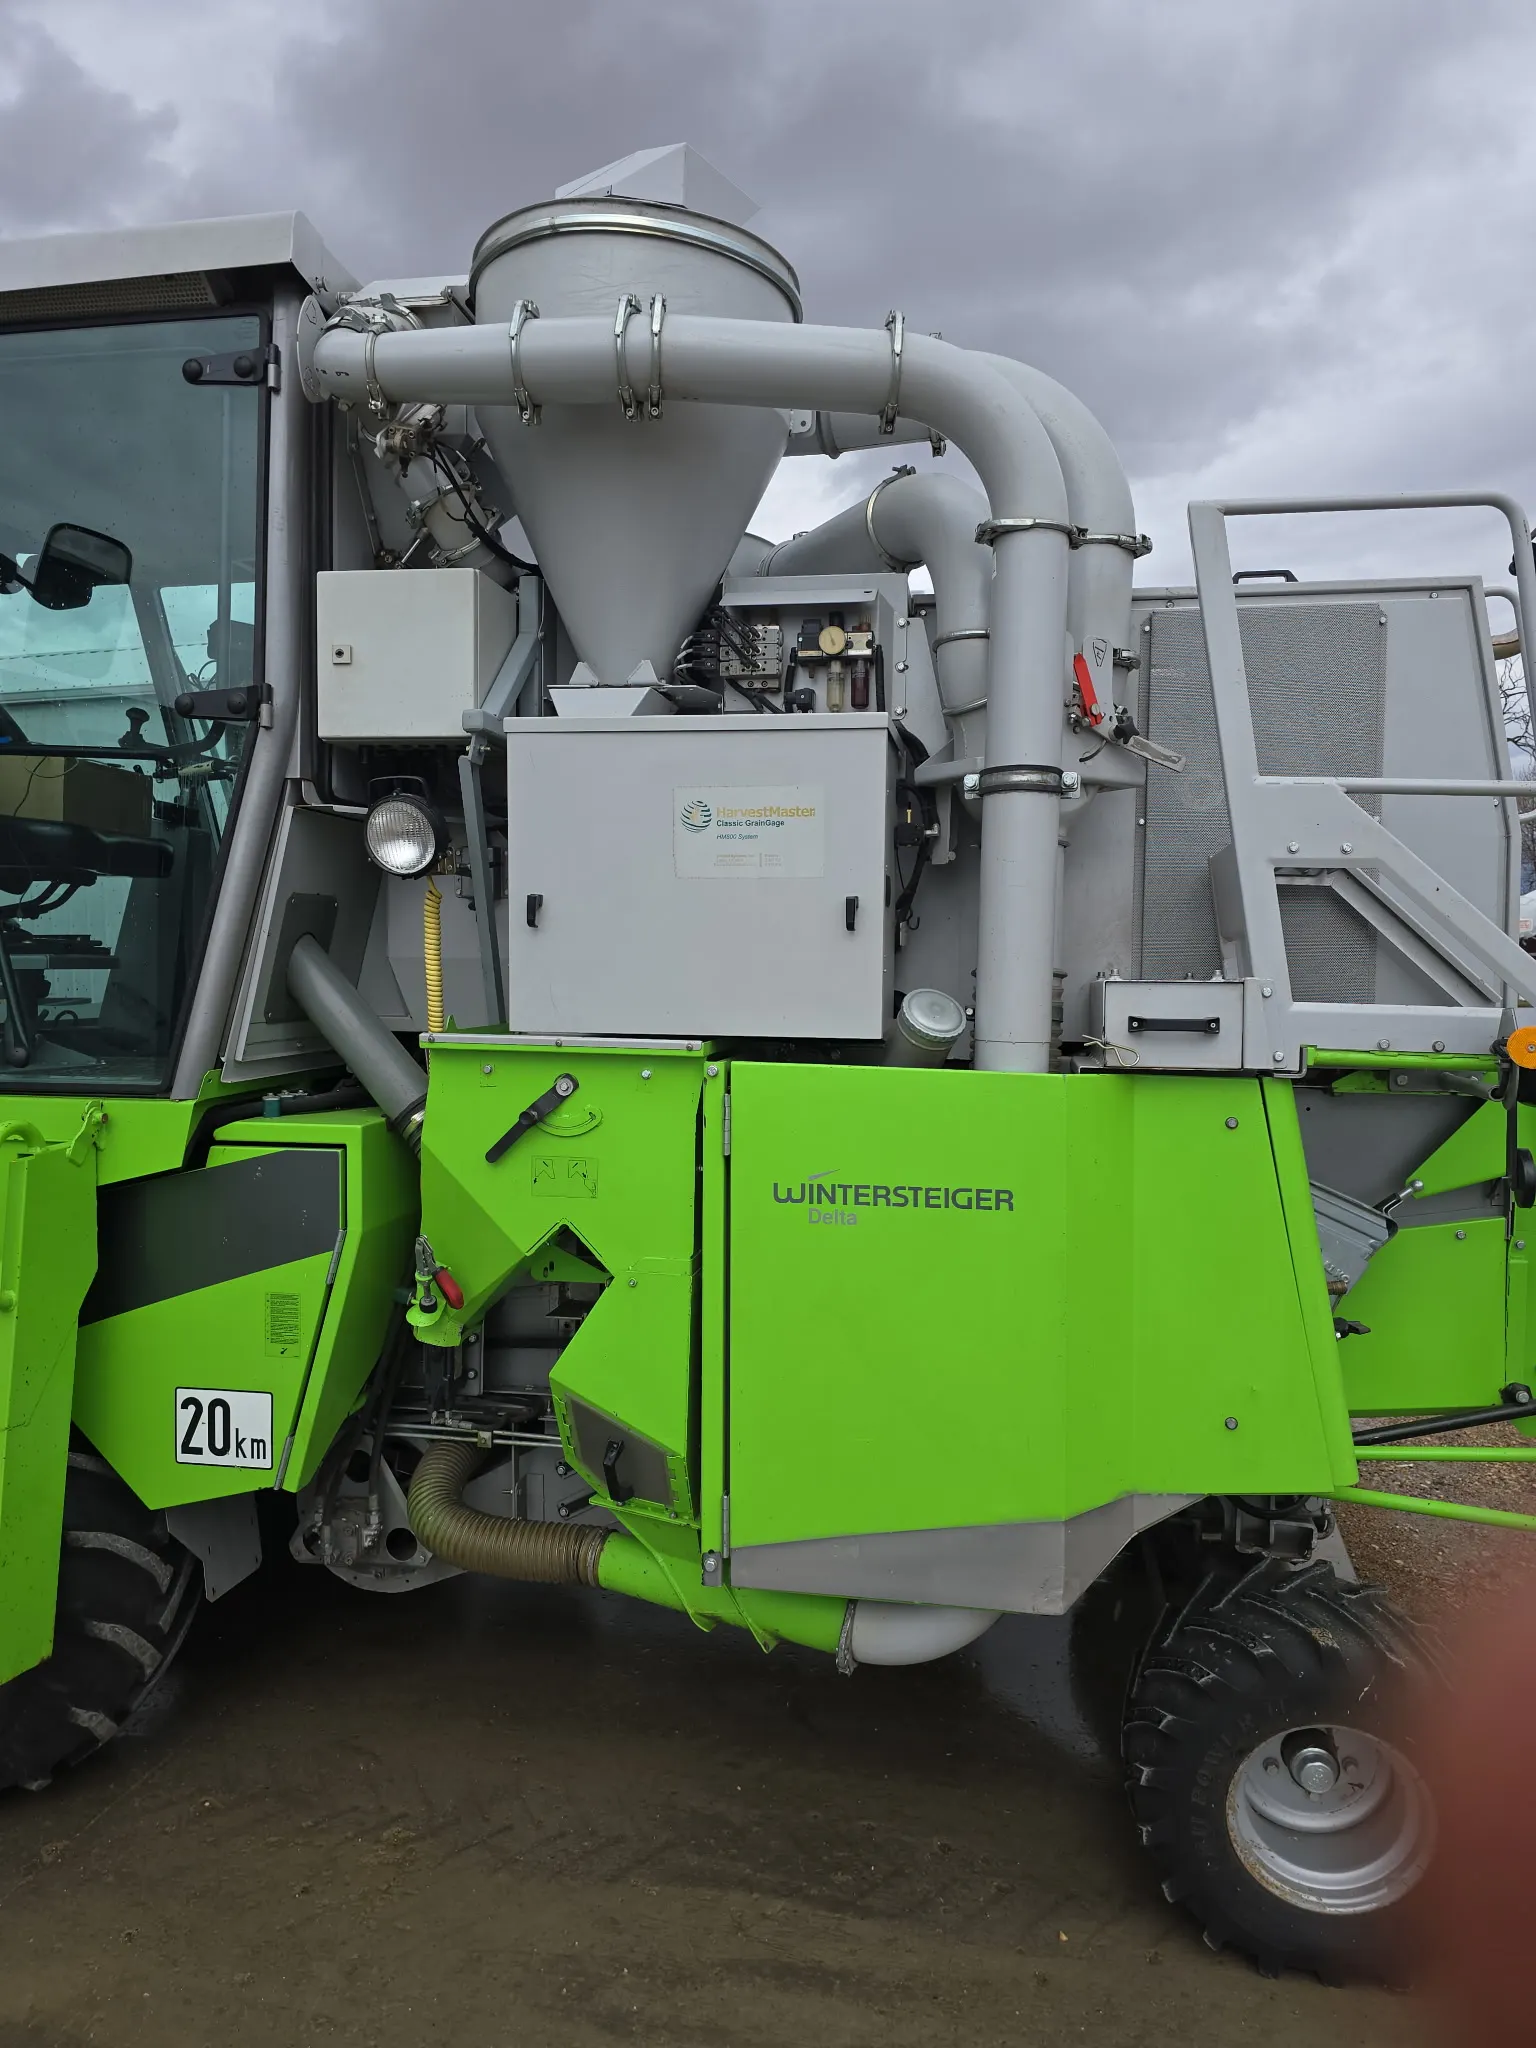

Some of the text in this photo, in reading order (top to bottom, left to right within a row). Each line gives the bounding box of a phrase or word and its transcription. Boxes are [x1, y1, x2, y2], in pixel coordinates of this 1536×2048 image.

[716, 805, 816, 819] HarvestMaster
[716, 819, 785, 829] Classic GrainGage
[738, 833, 759, 841] System
[772, 1181, 1014, 1212] WINTERSTEIGER
[808, 1208, 858, 1226] Delta
[180, 1396, 231, 1457] 20
